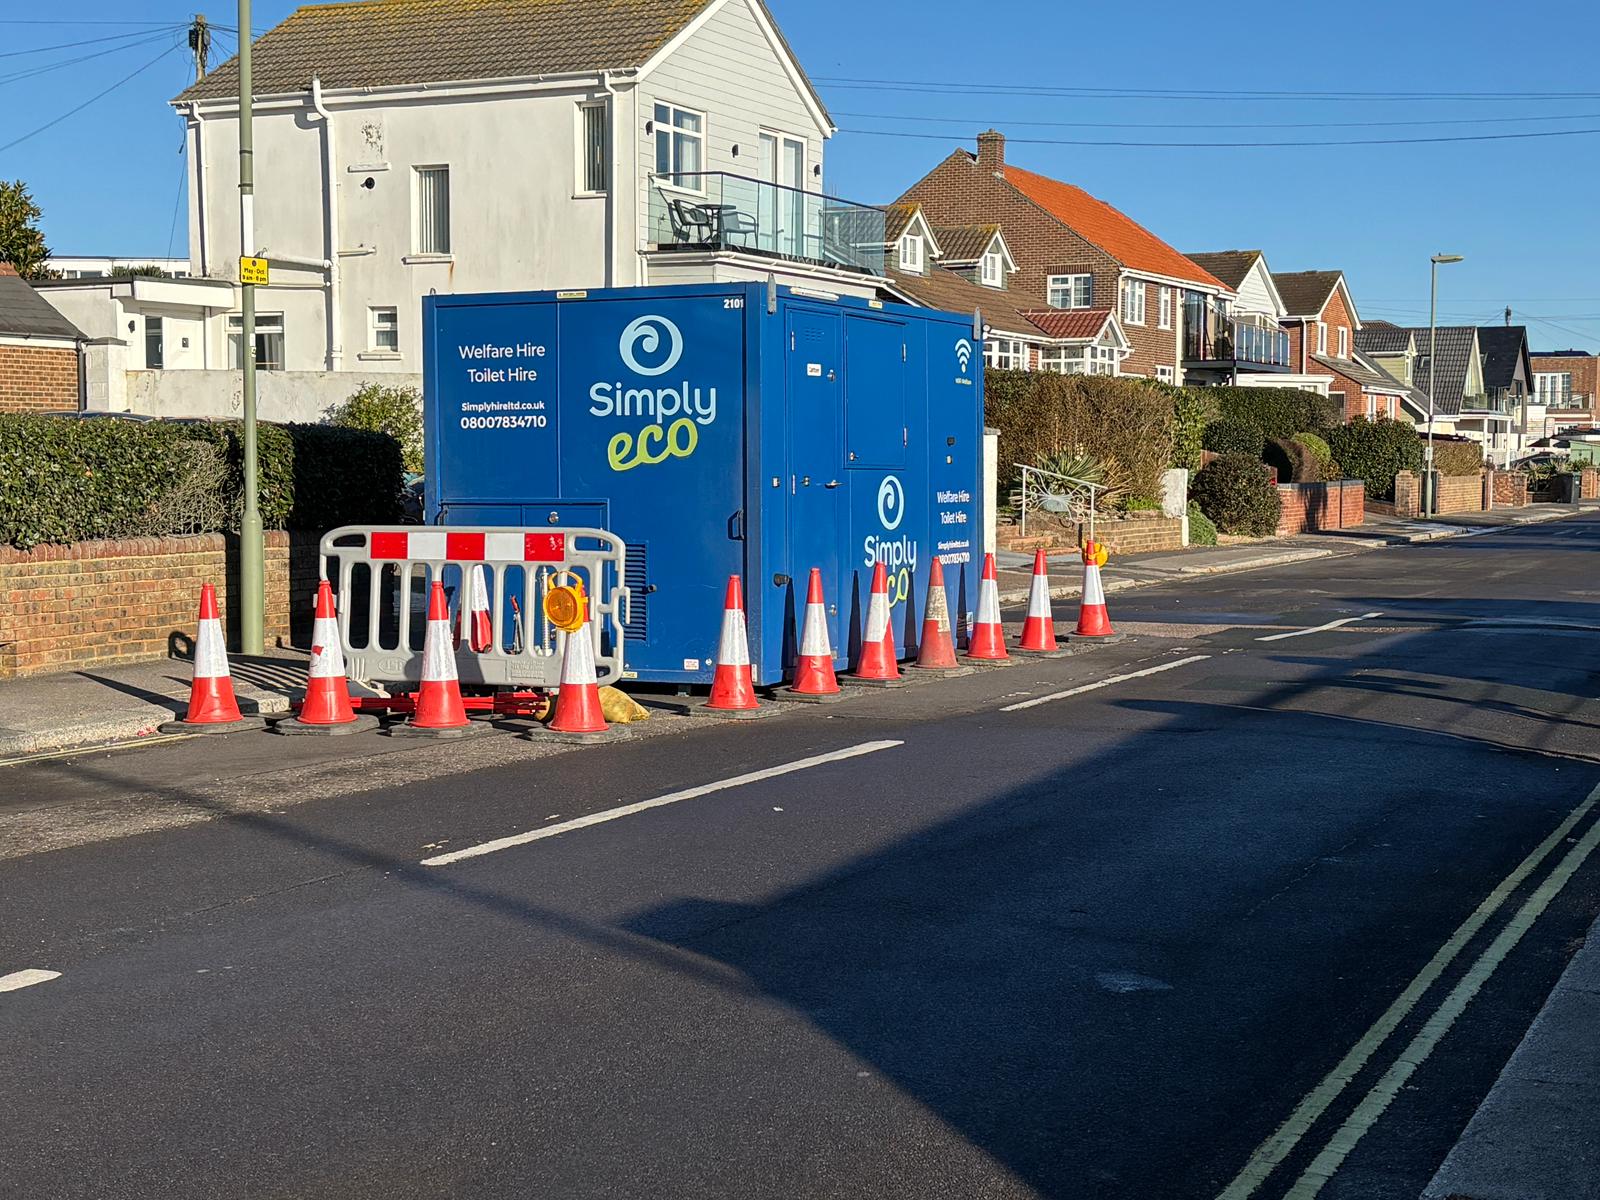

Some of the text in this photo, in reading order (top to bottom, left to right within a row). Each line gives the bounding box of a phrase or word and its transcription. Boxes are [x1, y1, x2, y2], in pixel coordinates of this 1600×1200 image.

[724, 298, 744, 309] 2101
[458, 342, 545, 359] Welfare Hire
[467, 367, 537, 382] Toilet Hire
[462, 400, 545, 412] Simplyhireltd.co.uk
[589, 381, 716, 424] Simply
[460, 416, 546, 428] 08007834710
[608, 418, 698, 471] eco
[937, 490, 970, 503] Welfare Hire
[940, 511, 966, 524] Toilet Hire
[864, 535, 917, 572] Simply
[887, 568, 909, 608] co
